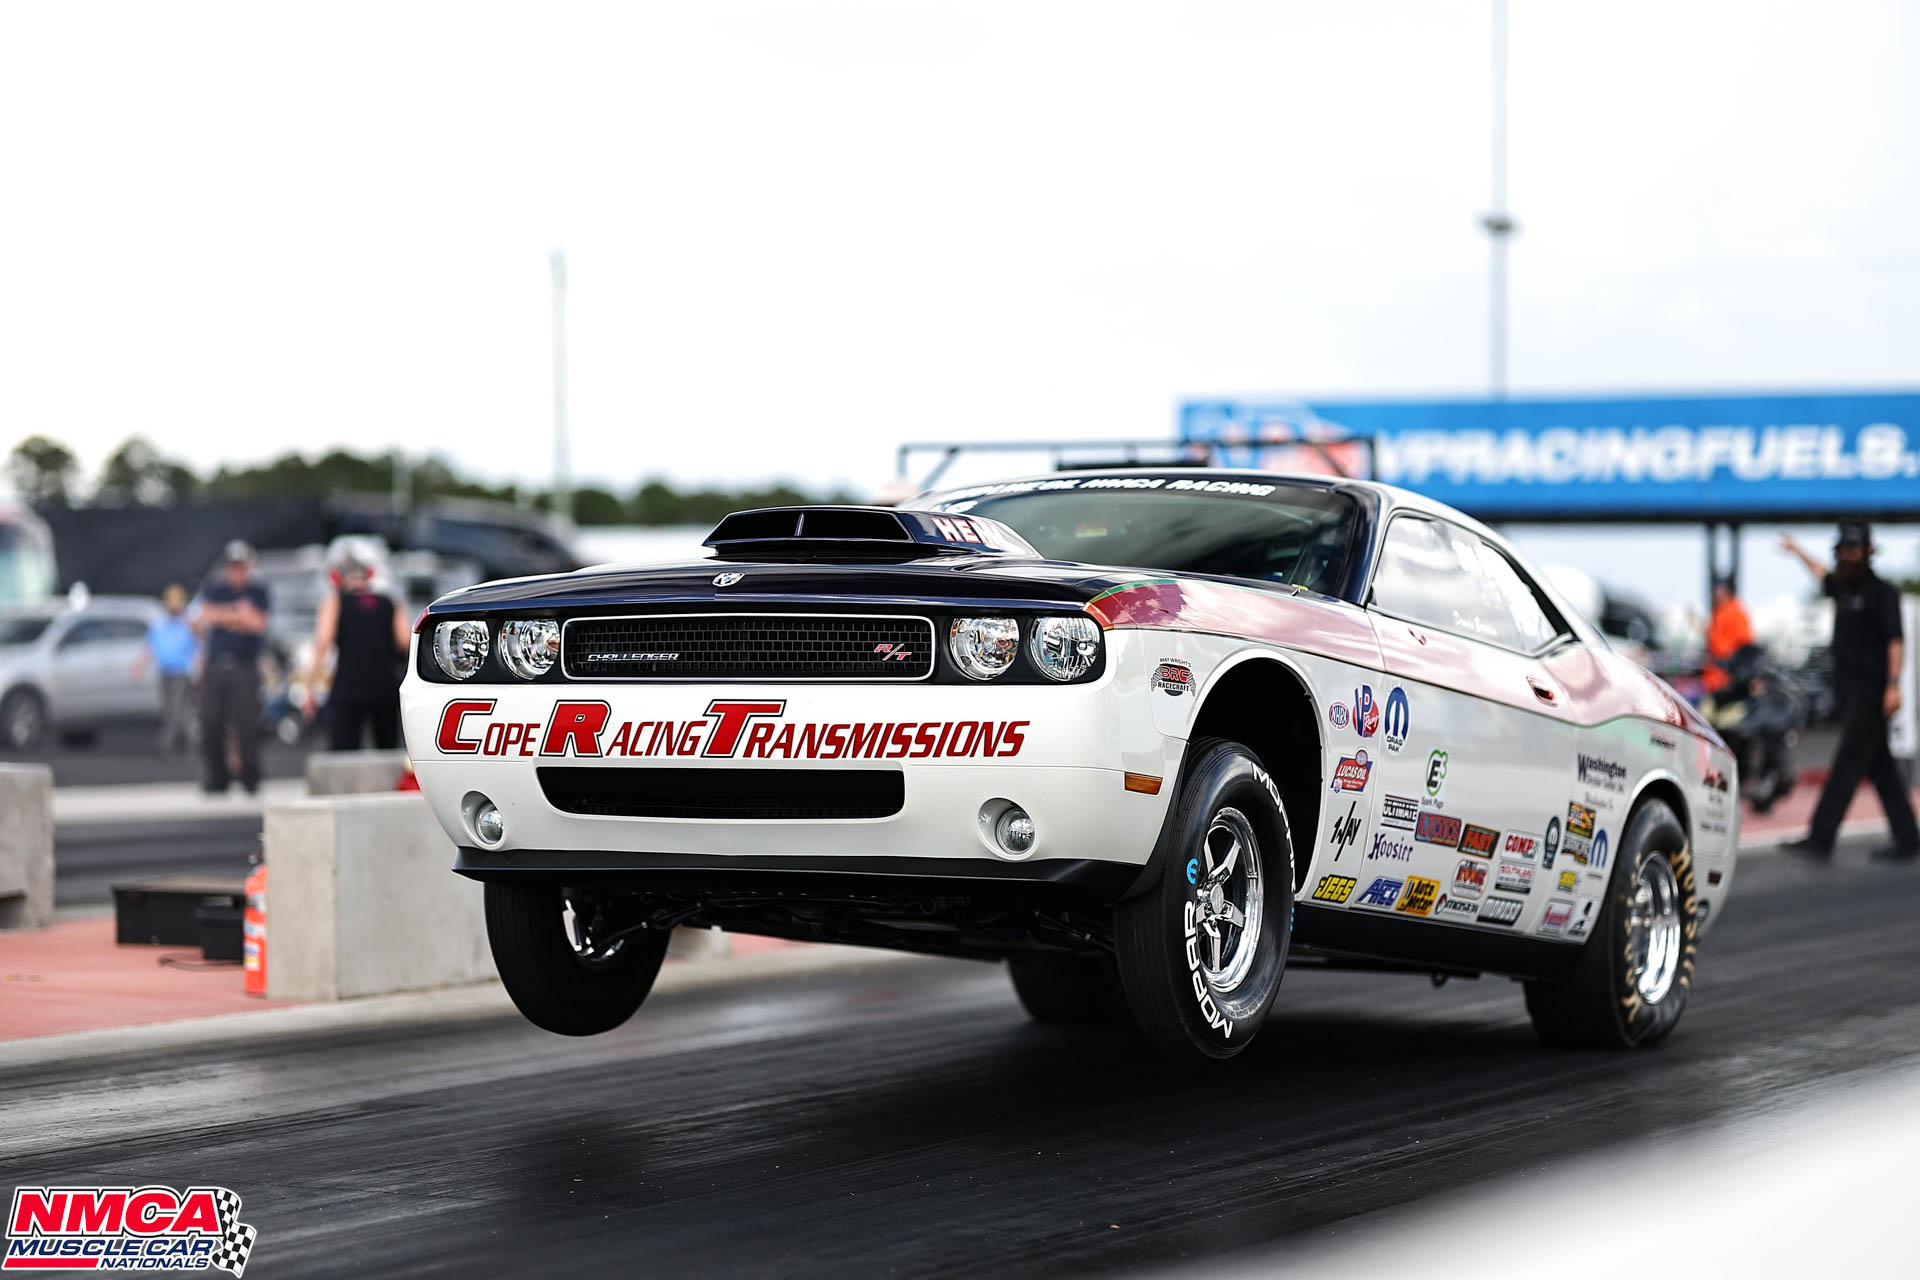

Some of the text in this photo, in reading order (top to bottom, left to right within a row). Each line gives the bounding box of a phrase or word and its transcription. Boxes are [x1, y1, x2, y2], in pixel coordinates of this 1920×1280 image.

[1165, 480, 1277, 497] RACING
[587, 652, 681, 662] CHALLENGER
[874, 643, 913, 661] R/T
[1158, 682, 1189, 692] RACECRAFT
[1331, 704, 1347, 726] NHRA
[1354, 684, 1373, 737] VP
[436, 698, 1030, 758] COPE RACING TRANSMISSIONS
[1386, 735, 1403, 746] DRAG
[1336, 764, 1368, 780] LUCAS OIL
[1383, 805, 1417, 821] ULTIMATE
[1463, 829, 1496, 853] FAST
[1505, 834, 1535, 854] COMP
[1313, 875, 1357, 903] JEGS
[1414, 879, 1436, 897] Auto
[1184, 900, 1234, 1039] MOPAR
